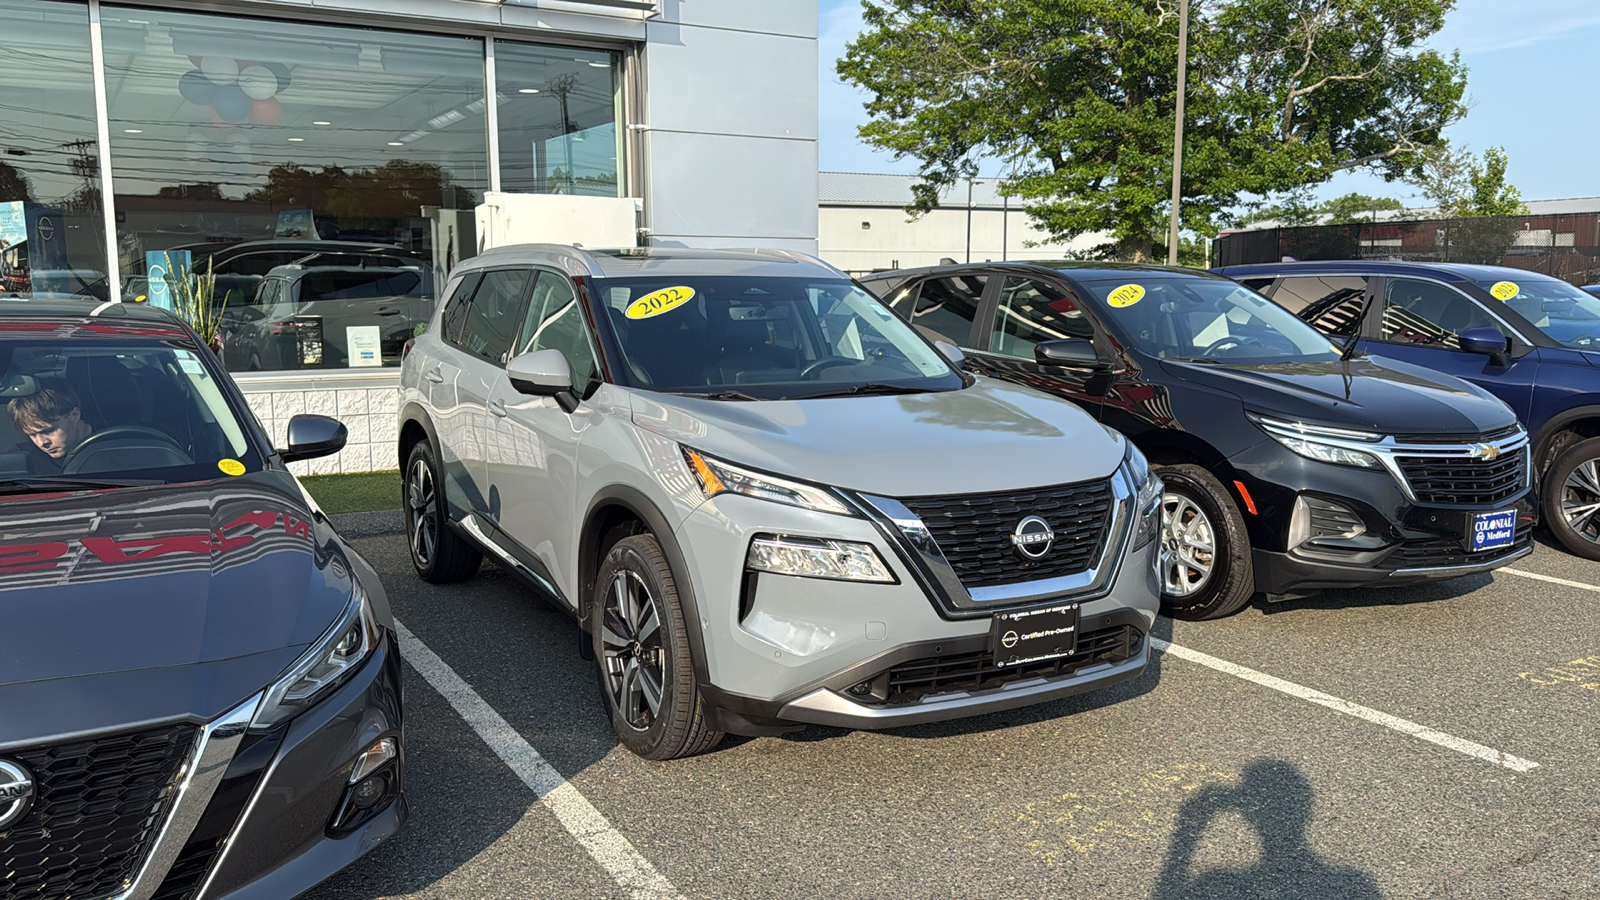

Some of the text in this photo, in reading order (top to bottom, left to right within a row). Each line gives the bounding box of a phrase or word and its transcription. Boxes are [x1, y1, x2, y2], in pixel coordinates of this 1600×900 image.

[638, 289, 683, 314] 2022
[1113, 285, 1139, 305] 2024
[1475, 517, 1512, 531] COLONIAL
[1014, 531, 1054, 543] NISSAN
[1487, 530, 1510, 540] Medford
[1021, 625, 1074, 640] Certified Pre-Owned
